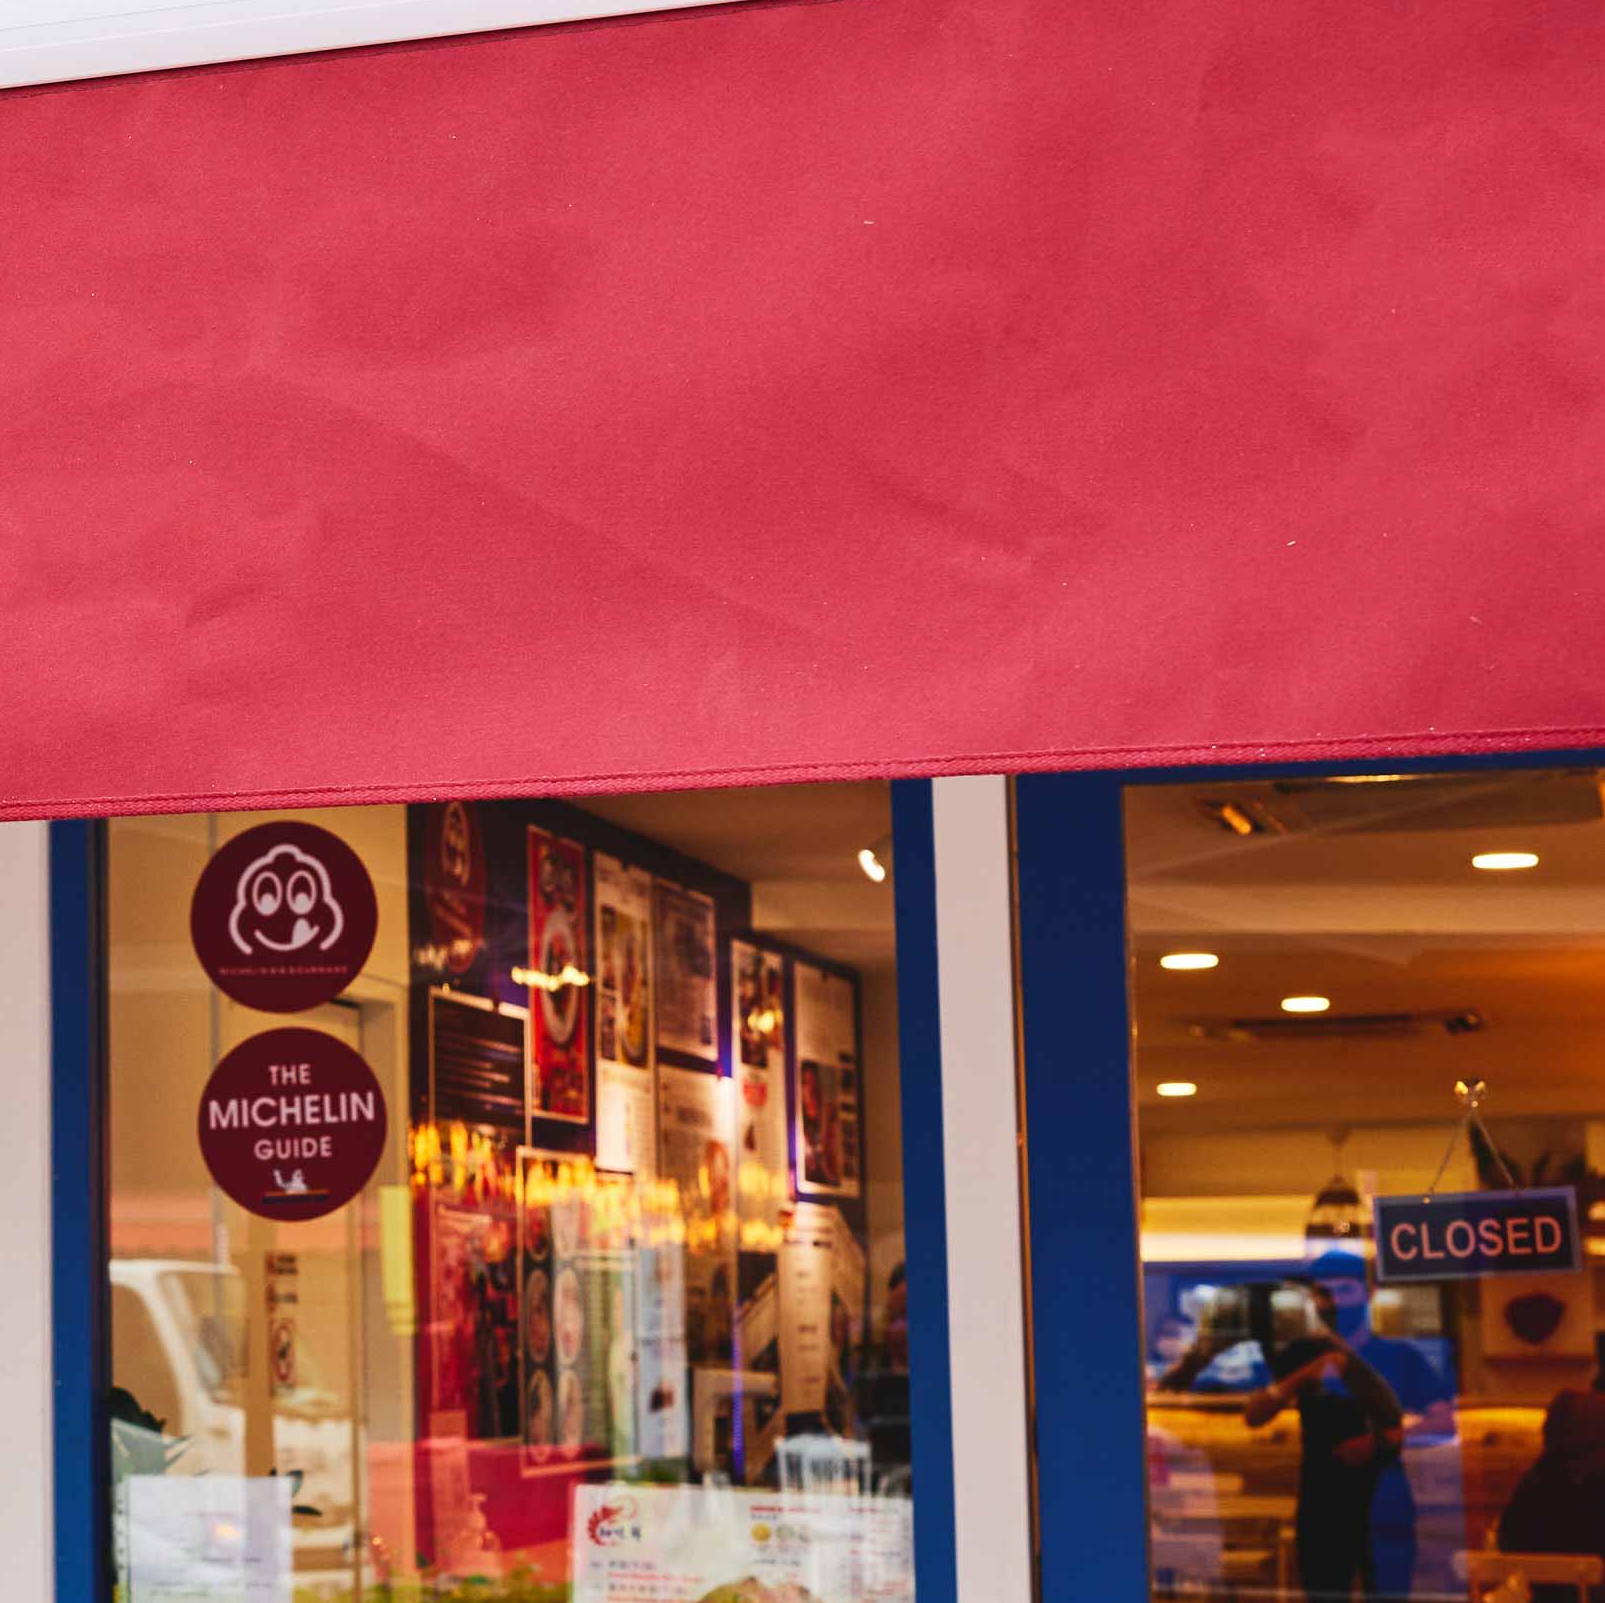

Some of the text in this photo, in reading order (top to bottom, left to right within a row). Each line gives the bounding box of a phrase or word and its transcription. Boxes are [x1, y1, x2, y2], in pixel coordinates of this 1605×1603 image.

[268, 1063, 312, 1086] THE
[208, 1090, 376, 1130] MICHELIN
[253, 1135, 333, 1161] GUIDE
[1390, 1215, 1563, 1262] CLOSED
